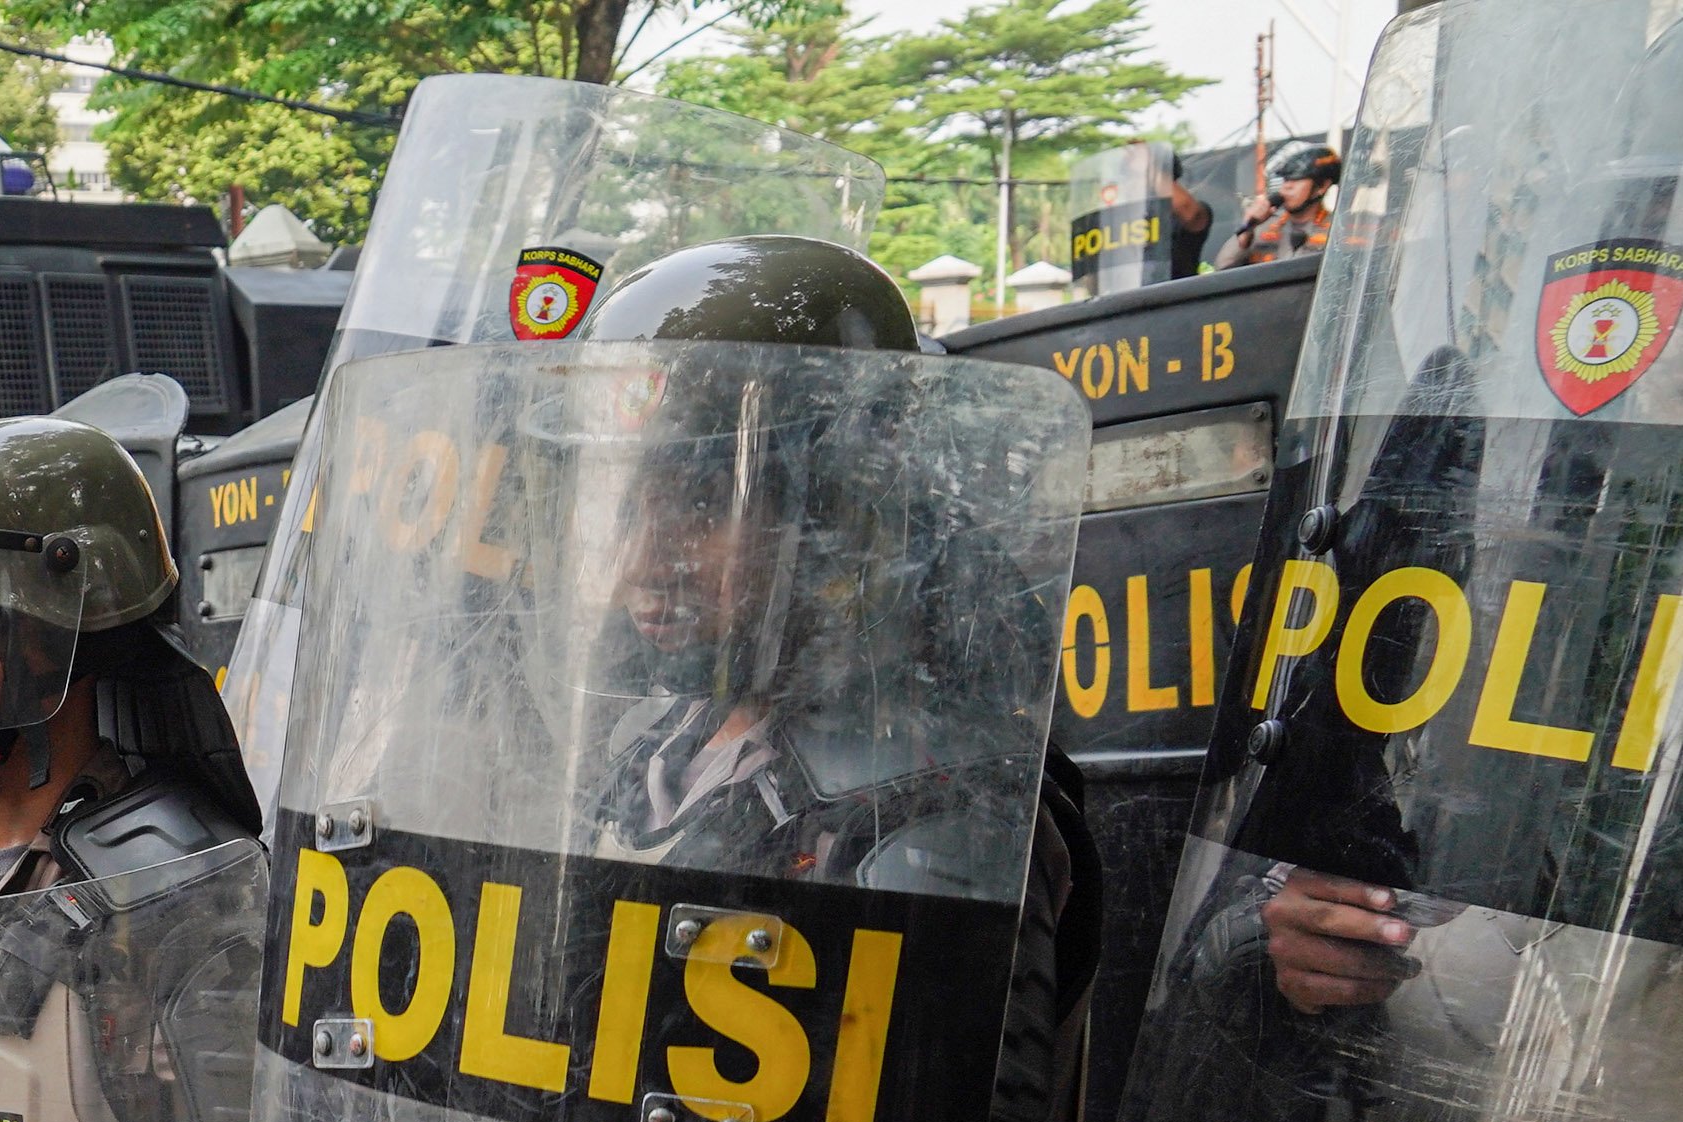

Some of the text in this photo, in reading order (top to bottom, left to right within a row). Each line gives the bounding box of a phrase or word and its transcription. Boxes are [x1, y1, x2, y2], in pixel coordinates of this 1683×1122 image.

[1072, 217, 1161, 260] POLISI
[1554, 248, 1610, 272] KORPS
[523, 251, 600, 278] KORPS SABHARA
[1053, 336, 1149, 399] YON
[1201, 322, 1235, 382] B
[209, 476, 257, 528] YON
